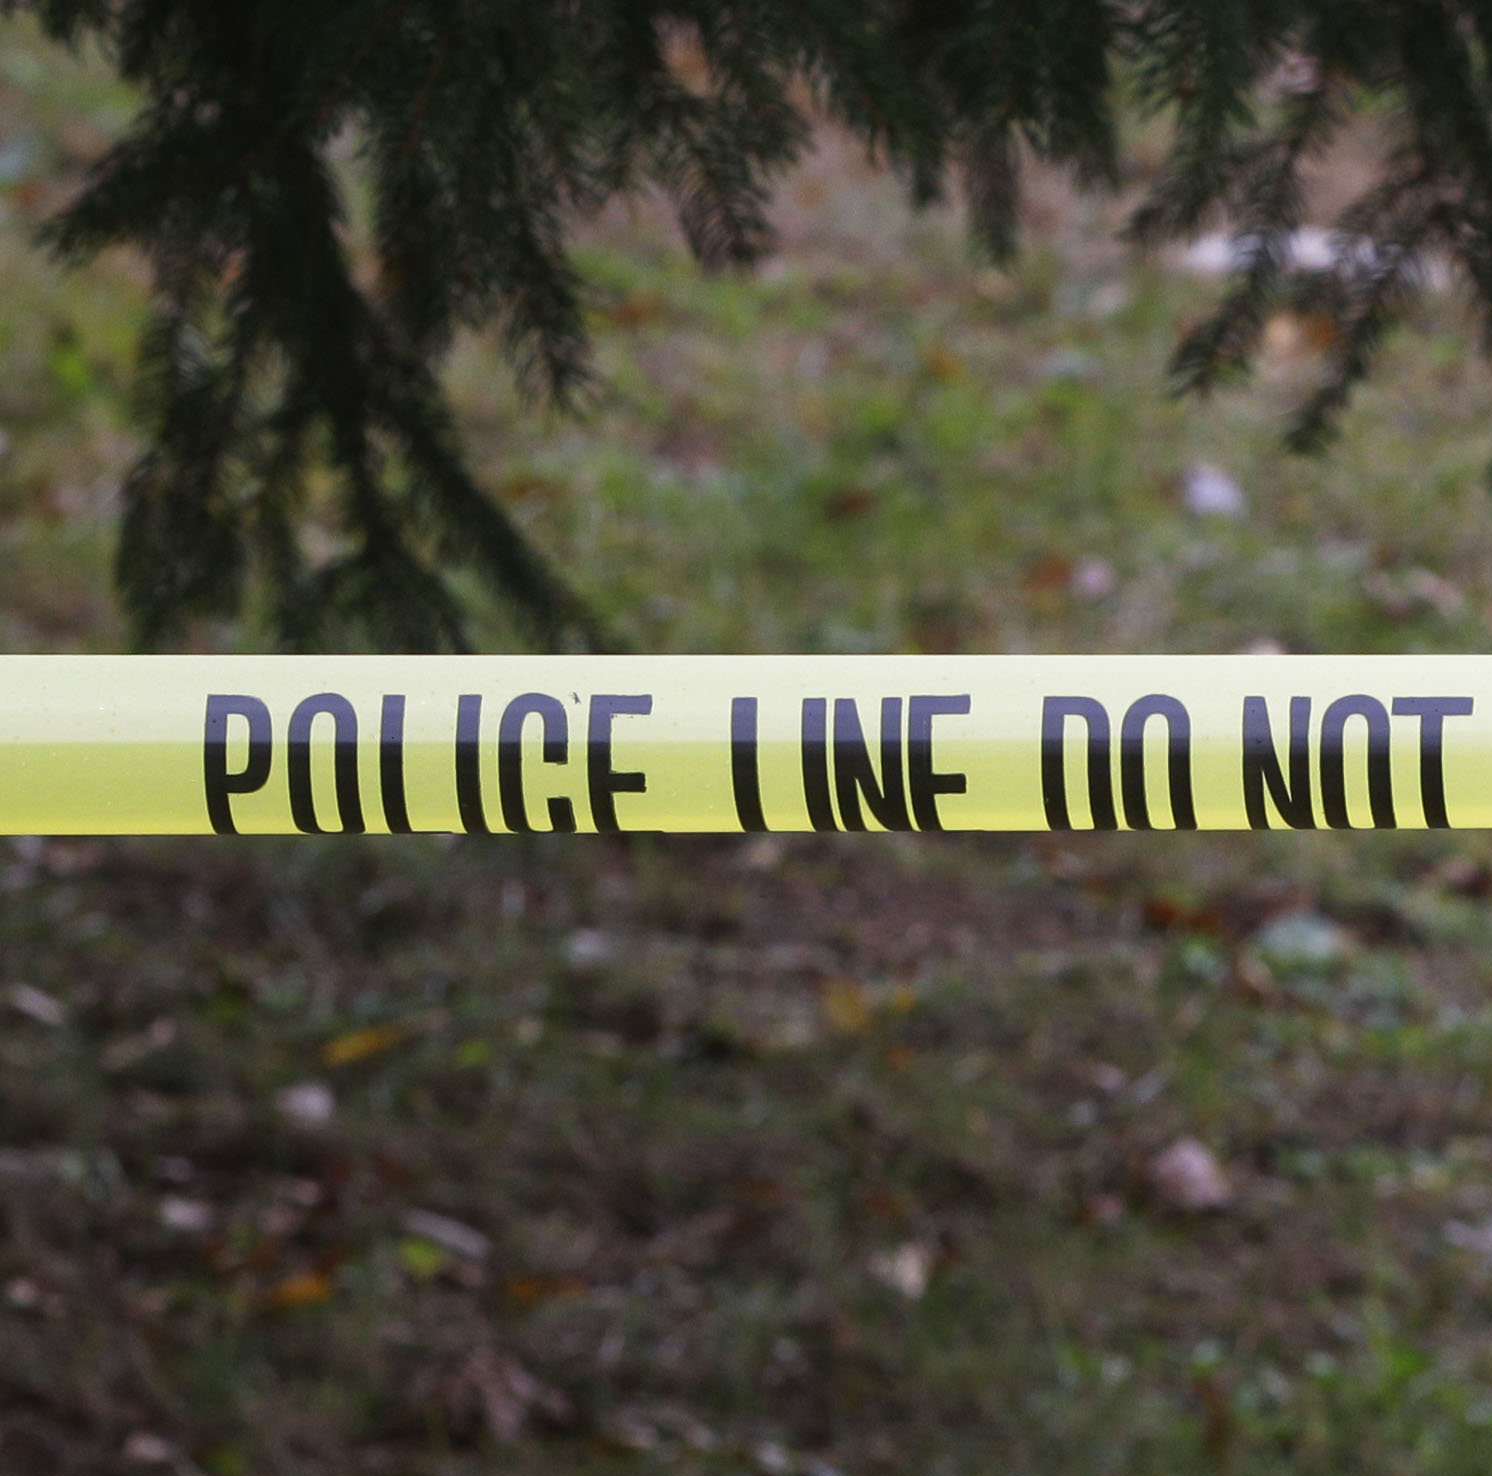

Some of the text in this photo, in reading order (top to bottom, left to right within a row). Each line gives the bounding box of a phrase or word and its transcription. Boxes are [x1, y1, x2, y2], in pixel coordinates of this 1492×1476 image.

[203, 692, 660, 835] POLICE
[730, 693, 980, 833] LINE
[1040, 693, 1198, 832] DO
[1241, 693, 1475, 831] NOT
